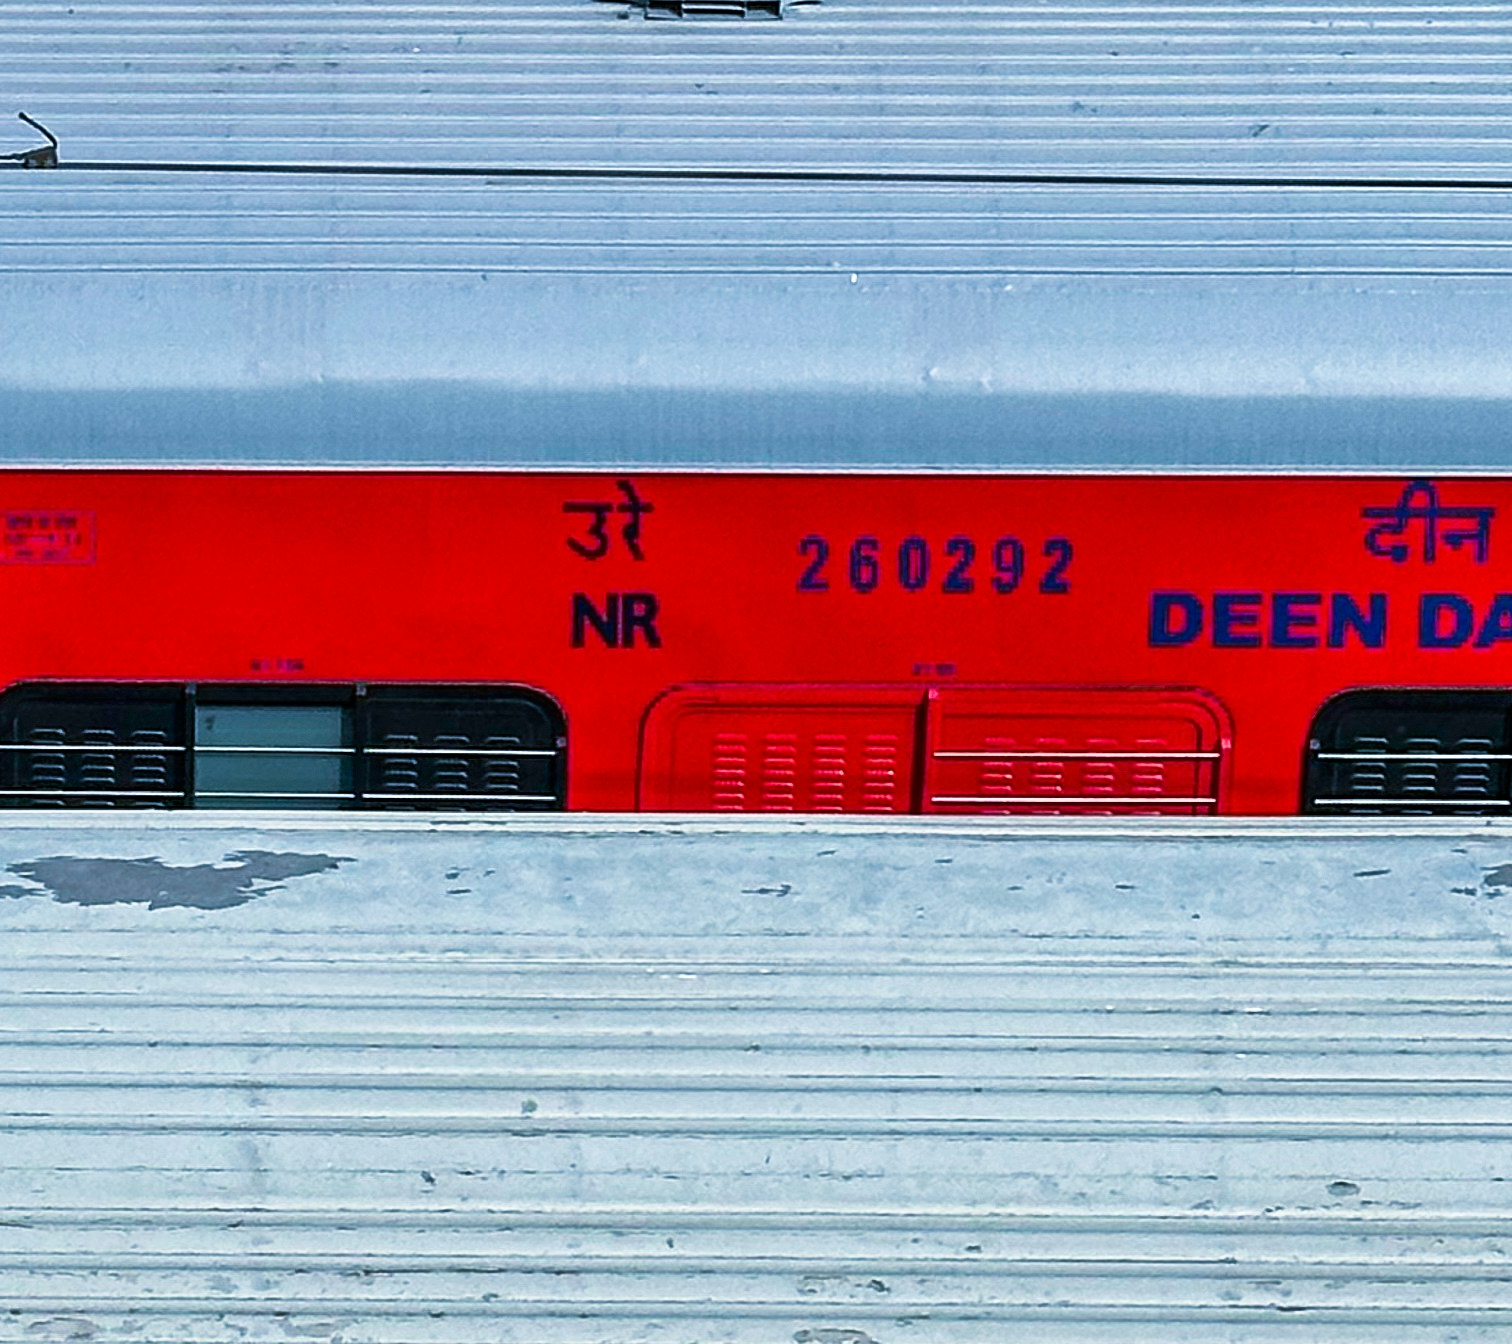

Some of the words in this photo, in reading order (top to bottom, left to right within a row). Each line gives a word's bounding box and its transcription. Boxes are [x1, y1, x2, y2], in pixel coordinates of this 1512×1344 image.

[1361, 479, 1496, 563] दीन
[795, 535, 1075, 593] 260292
[571, 592, 663, 649] NR
[1148, 591, 1388, 649] DEEN
